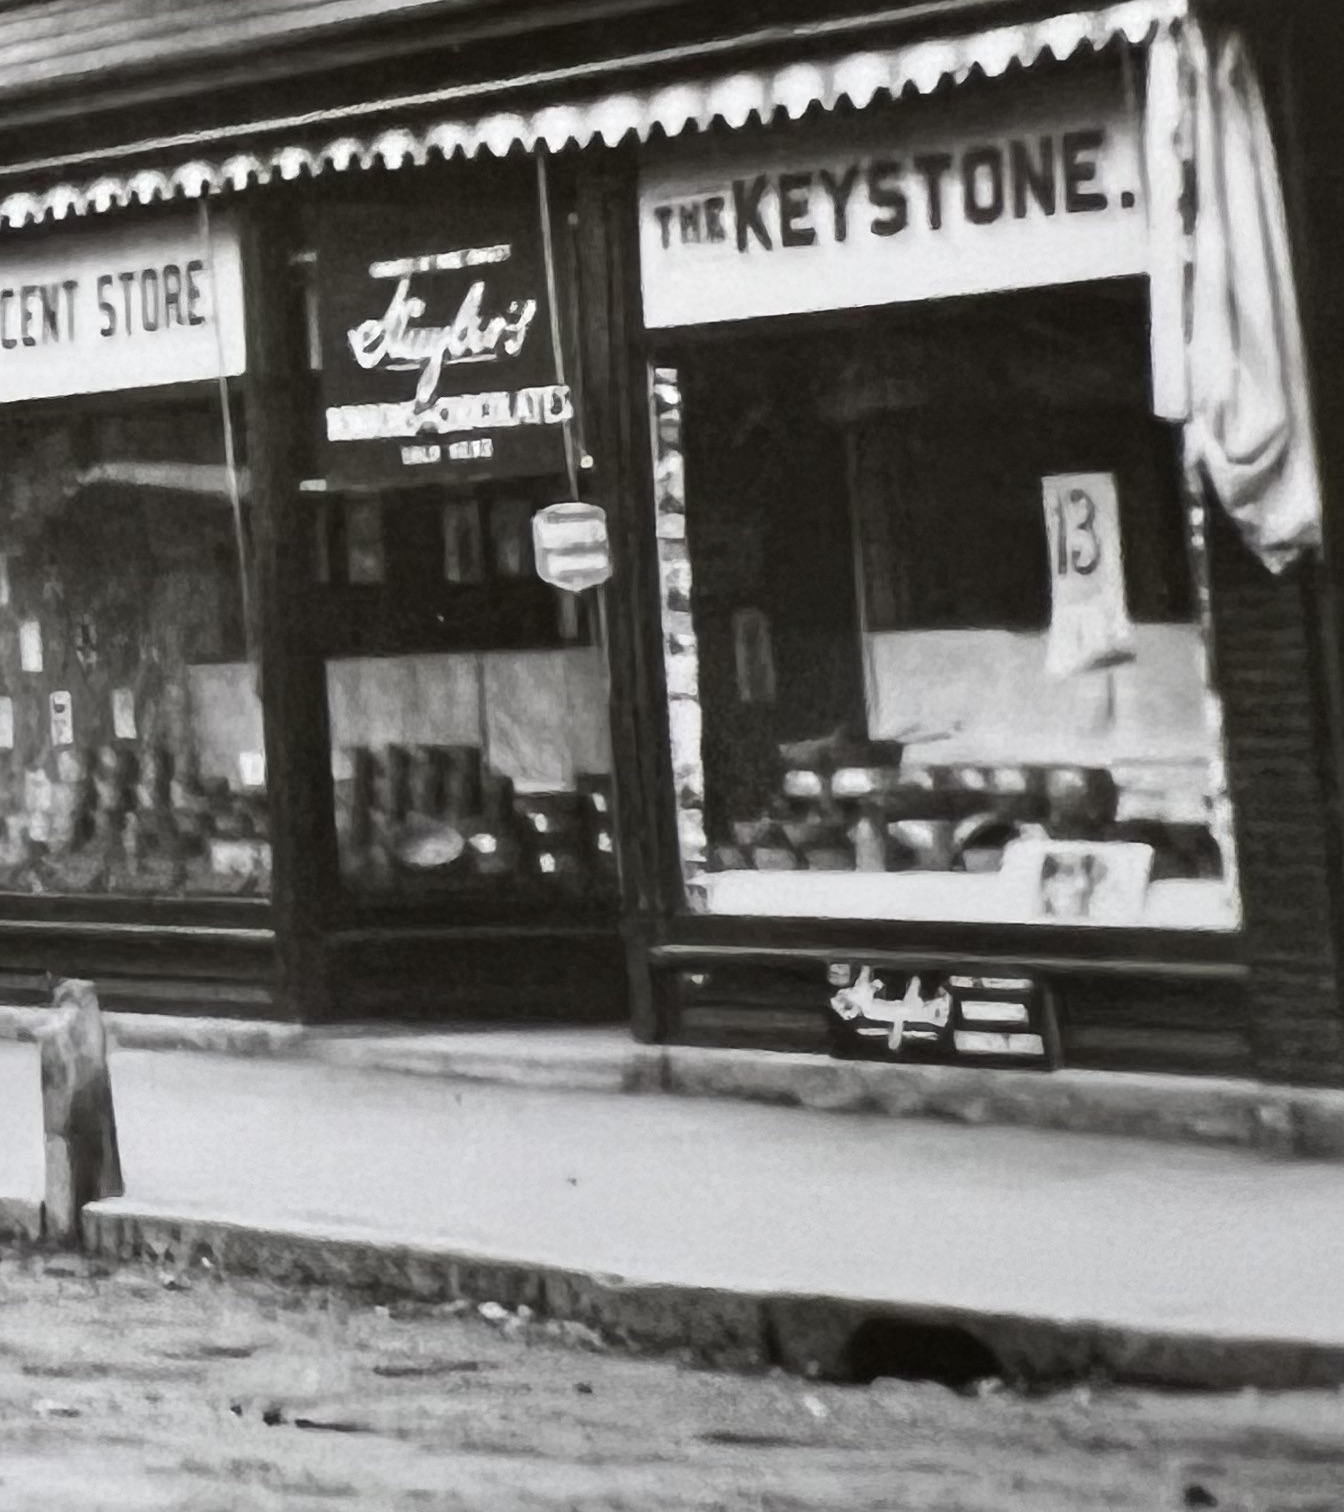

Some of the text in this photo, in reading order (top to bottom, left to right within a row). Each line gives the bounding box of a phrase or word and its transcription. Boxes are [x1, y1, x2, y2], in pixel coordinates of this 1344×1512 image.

[653, 129, 1136, 253] THE KEYSTONE.
[0, 279, 79, 350] CENT
[97, 259, 206, 338] STORE
